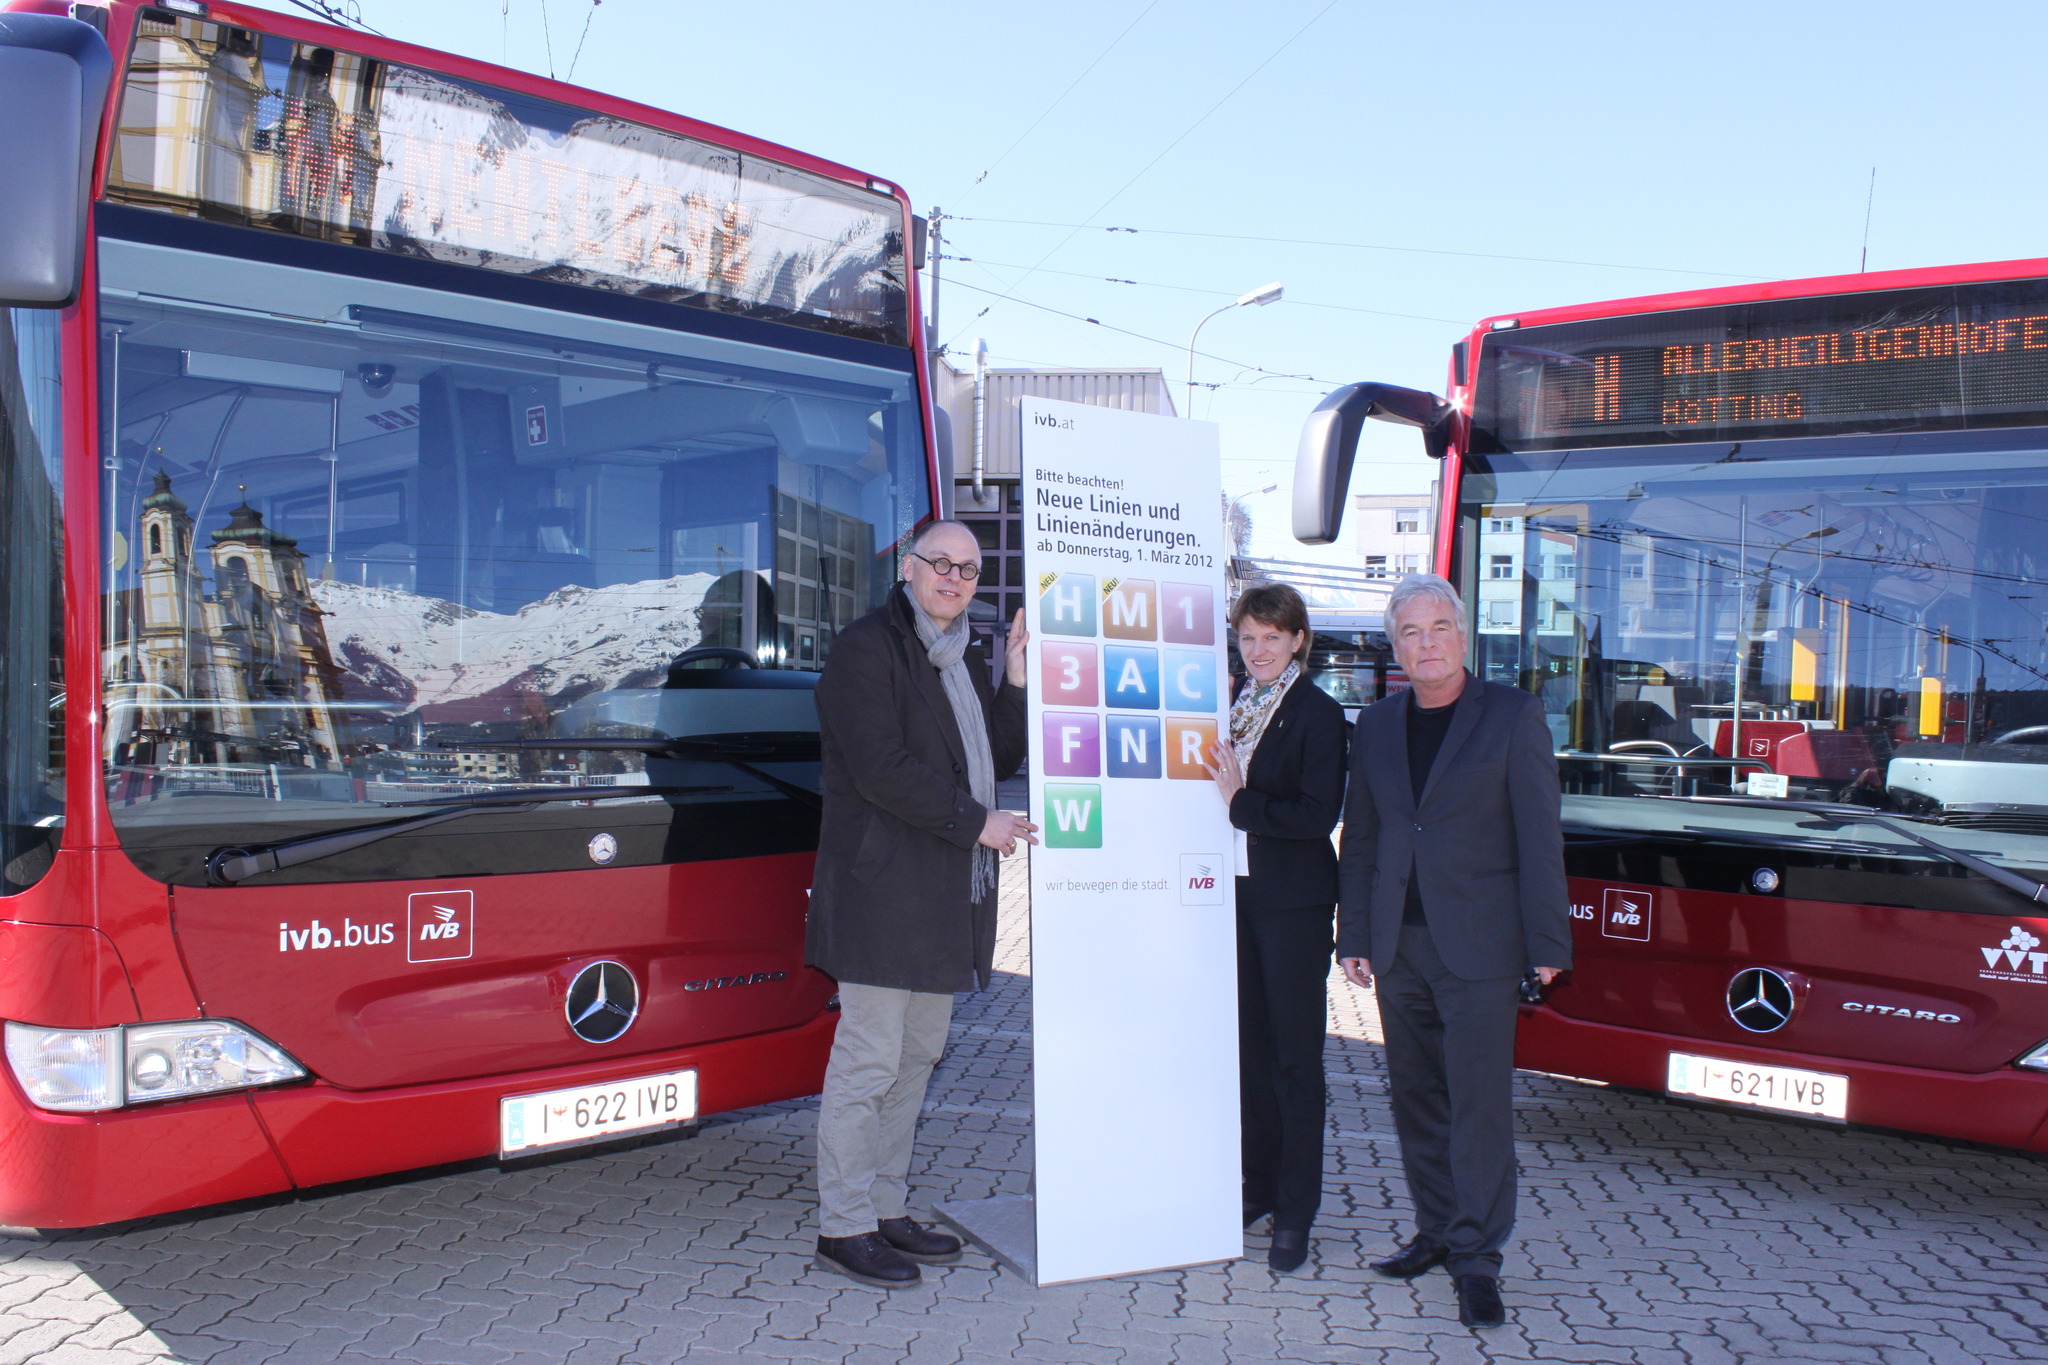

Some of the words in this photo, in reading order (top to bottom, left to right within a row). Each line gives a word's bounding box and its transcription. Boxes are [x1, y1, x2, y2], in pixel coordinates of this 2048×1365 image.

[1594, 355, 1621, 421] H
[1034, 411, 1075, 431] ivb.at
[1663, 392, 1802, 425] HÖTTING
[1035, 468, 1063, 483] Bitte
[1067, 472, 1124, 490] beachten!
[1036, 487, 1083, 510] Neue
[1090, 494, 1142, 517] Linien
[1148, 503, 1180, 521] und
[1037, 513, 1201, 550] Linienänderungen.
[1037, 538, 1053, 552] ab
[1057, 540, 1133, 563] Donnerstag,
[1137, 549, 1148, 562] 1.
[1151, 549, 1180, 565] März
[1184, 553, 1213, 568] 2012
[1040, 571, 1058, 590] NEU!
[1103, 577, 1120, 595] NEU!
[1054, 584, 1082, 623] H
[1111, 590, 1148, 628] M
[1179, 596, 1193, 630] 1
[1060, 655, 1081, 690] 3
[1116, 658, 1147, 694] A
[1177, 662, 1202, 699] C
[1062, 726, 1081, 763] F
[1120, 727, 1147, 764] N
[1181, 730, 1205, 765] R
[1053, 799, 1091, 832] W
[1045, 878, 1063, 892] wir
[1067, 878, 1118, 894] bewegen
[1121, 878, 1138, 891] die
[1141, 878, 1171, 892] stadt.
[1188, 877, 1215, 890] IVB
[420, 922, 460, 941] IVB
[1611, 911, 1641, 926] IVB
[279, 918, 395, 952] ivb.bus
[1980, 947, 2048, 975] VVT
[684, 970, 788, 992] CITARO
[1841, 1001, 1961, 1024] CITARO
[1703, 1065, 1708, 1089] I
[1730, 1070, 1774, 1099] 621
[1784, 1077, 1825, 1106] IVB
[543, 1103, 548, 1135] I
[575, 1091, 627, 1128] 622
[637, 1082, 678, 1118] IVB
